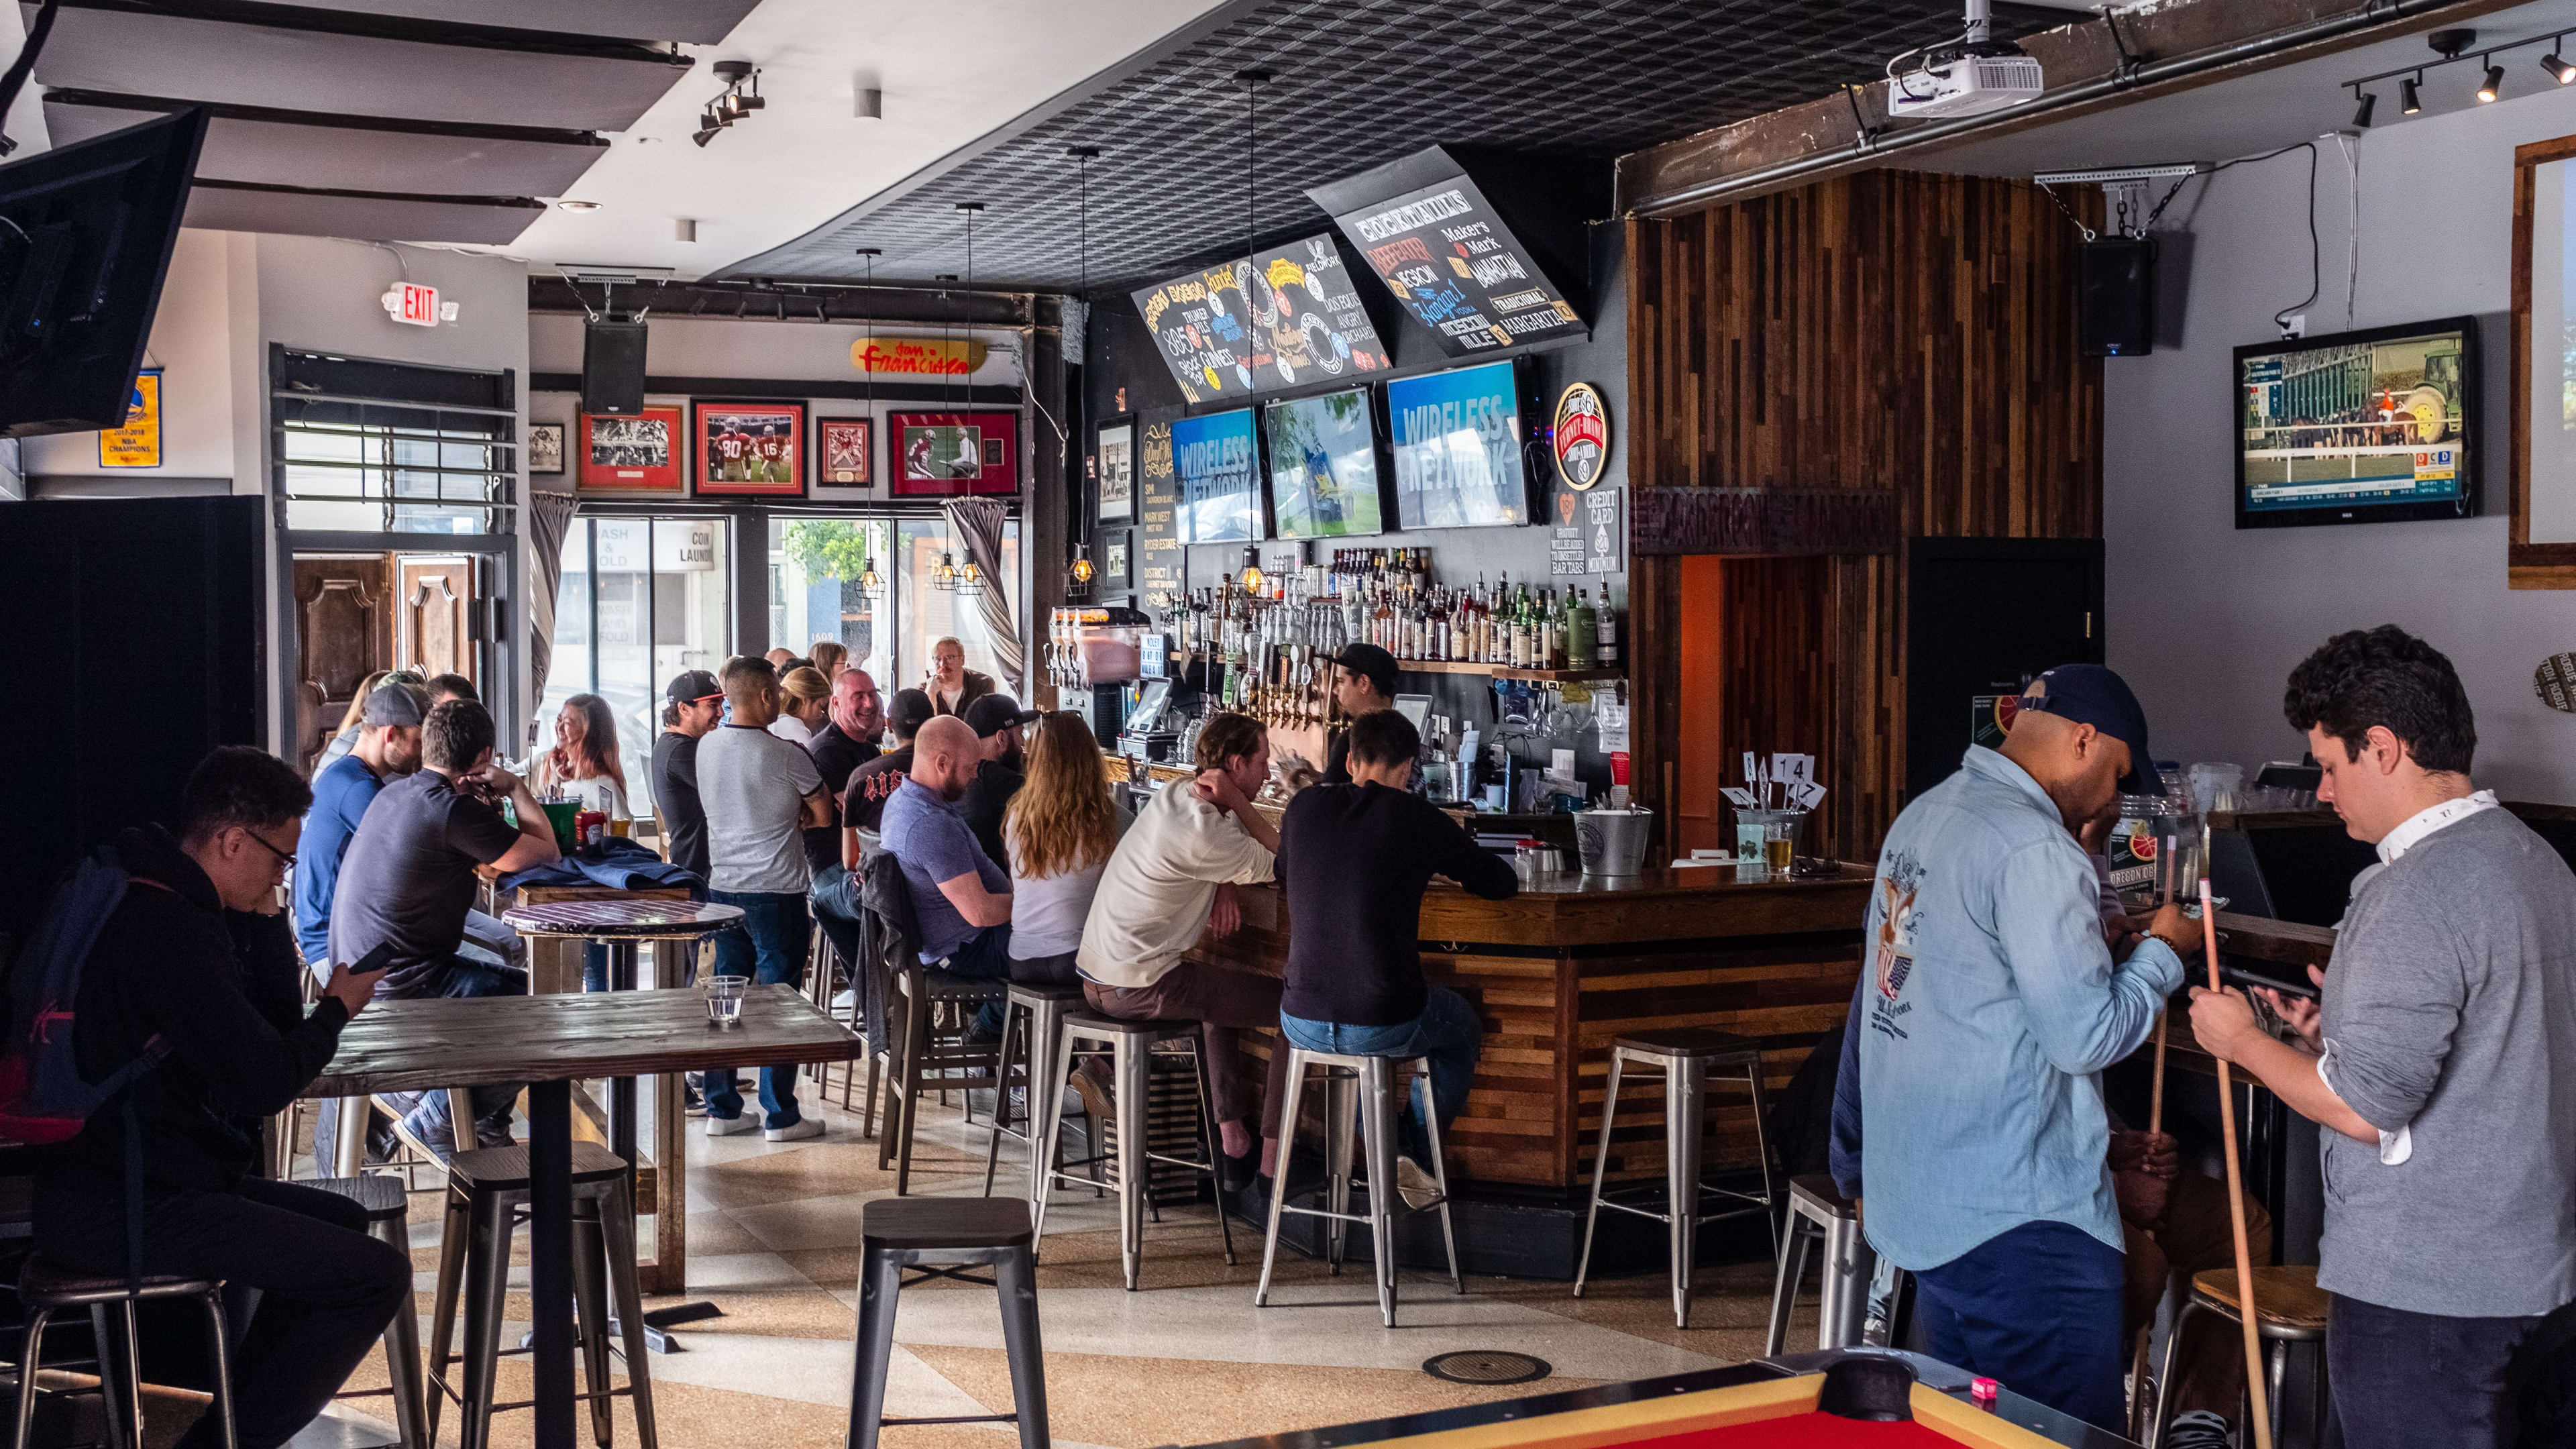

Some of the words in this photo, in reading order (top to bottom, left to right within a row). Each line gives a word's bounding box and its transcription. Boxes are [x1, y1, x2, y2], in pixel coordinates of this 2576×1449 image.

[1357, 191, 1470, 241] COCKTAILS
[1440, 221, 1491, 242] Maker's
[1464, 236, 1502, 254] Mark
[1305, 255, 1341, 274] FIELDWORK
[1366, 237, 1436, 276] BEEFEATER
[1395, 264, 1440, 288] NEGRONI
[1466, 252, 1529, 288] MANHATTAN
[405, 286, 433, 321] EXIT
[1146, 292, 1168, 331] DRAFT
[1169, 283, 1205, 301] BEERS
[1324, 297, 1341, 313] DOS
[1340, 292, 1362, 310] EQUIS
[1412, 289, 1460, 327] Hangar
[1454, 305, 1478, 315] VODKA
[1494, 291, 1546, 311] TRADICIONAL
[1182, 307, 1210, 323] TRUMER
[1337, 311, 1362, 329] ANGRY
[1499, 309, 1568, 335] MARGARITA
[1193, 321, 1210, 334] PILS
[1438, 313, 1491, 336] MOSCOW
[1163, 327, 1194, 356] 805
[1342, 326, 1375, 344] ORCHARD
[1458, 331, 1497, 349] MULE
[1178, 355, 1202, 376] SHOCK
[1199, 348, 1236, 369] GUINNESS
[1190, 370, 1207, 386] TOP
[1403, 394, 1503, 446] WIRELESS
[1560, 417, 1603, 454] FERNET-BRANC
[722, 440, 741, 459] 80
[764, 442, 778, 456] 16
[1181, 435, 1248, 478] WIRELESS
[1183, 473, 1250, 505] NETWORK
[1587, 490, 1615, 508] CREDIT
[1591, 508, 1613, 525] CARD
[692, 532, 710, 545] COIN
[1556, 527, 1578, 538] GRATUITY
[604, 543, 613, 552] &
[1551, 540, 1564, 550] WILL
[1564, 540, 1571, 550] BE
[1570, 539, 1585, 549] ADDED
[599, 555, 627, 567] OLD
[680, 549, 713, 562] LAUND
[1551, 551, 1558, 561] TO
[1558, 551, 1585, 561] UNSETTLED
[1589, 556, 1616, 572] MINIMUM
[1144, 568, 1166, 579] DISTRICT
[1552, 562, 1567, 574] BAR
[1567, 561, 1584, 574] TABS
[2559, 653, 2576, 682] ROGUE
[2110, 867, 2141, 885] OREGON
